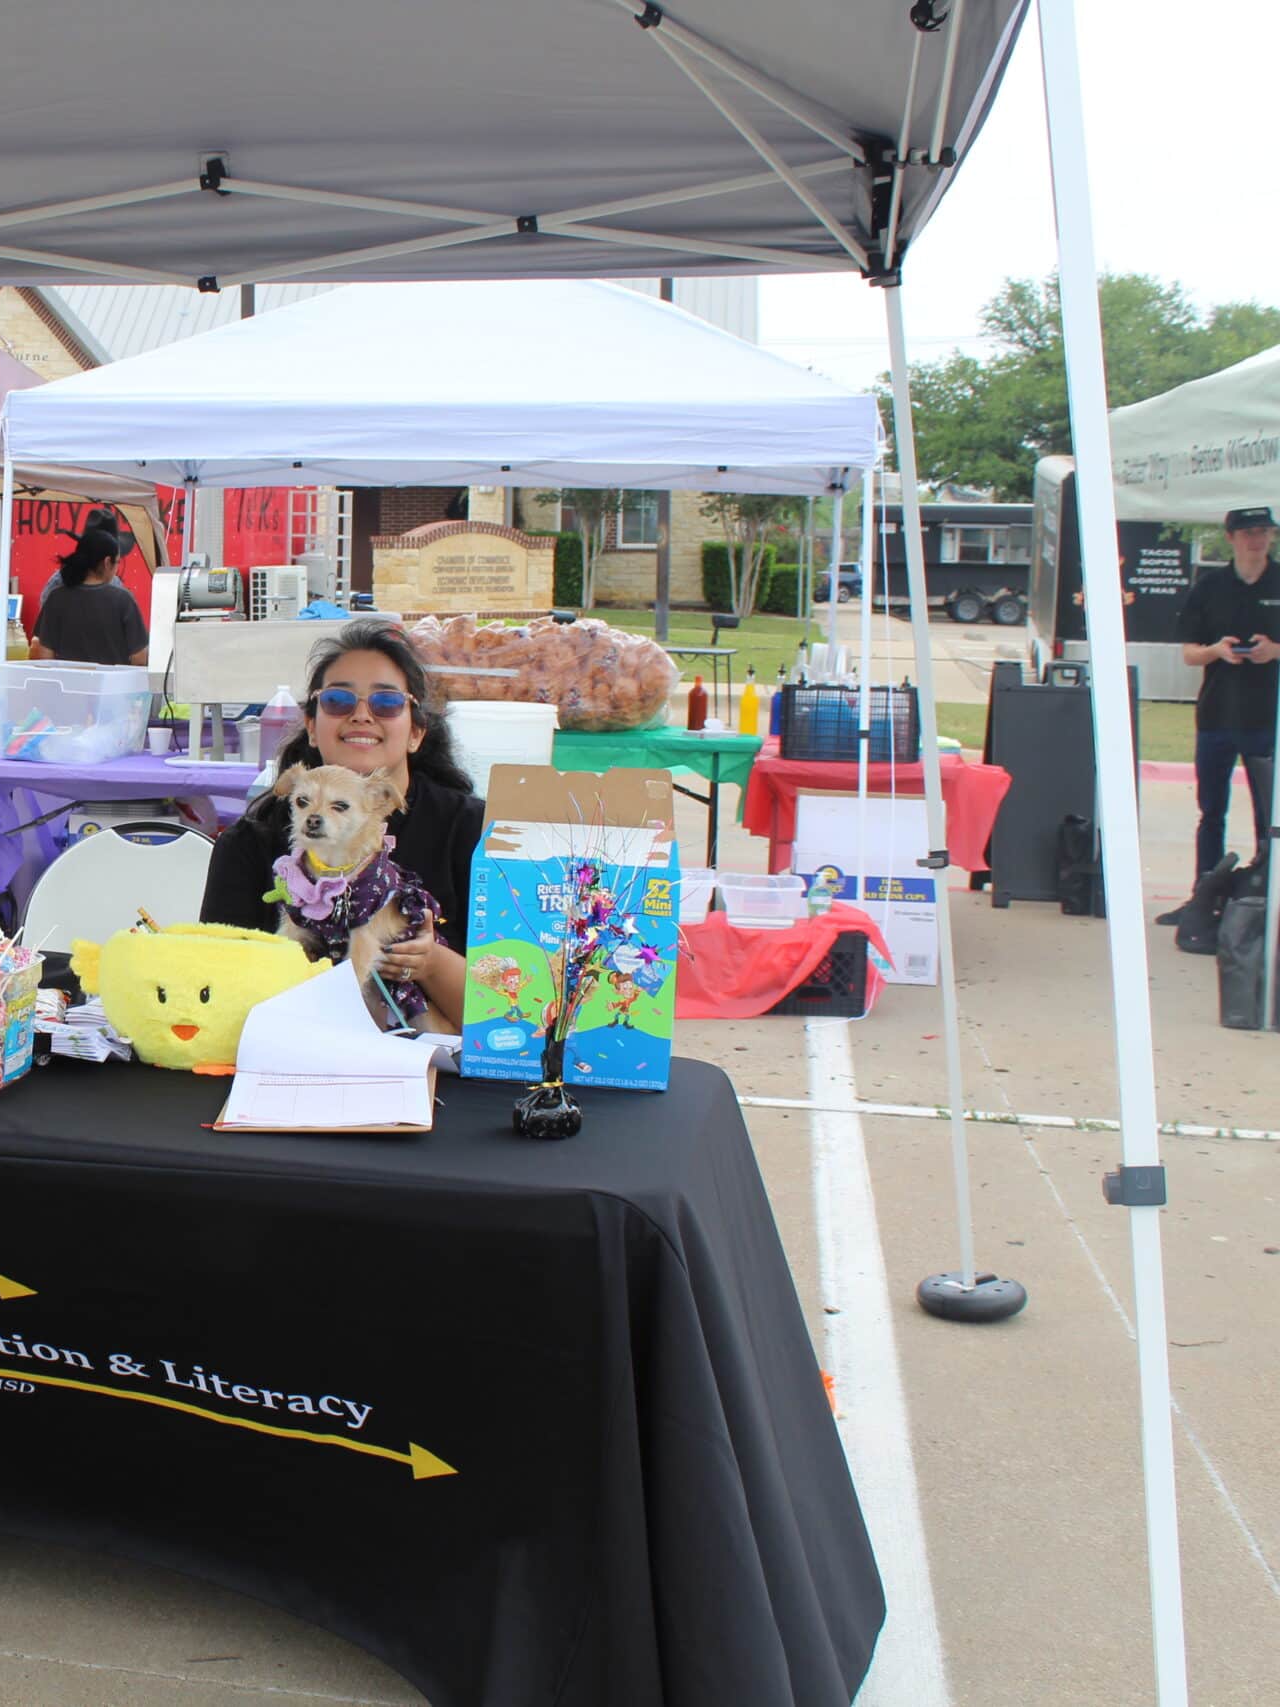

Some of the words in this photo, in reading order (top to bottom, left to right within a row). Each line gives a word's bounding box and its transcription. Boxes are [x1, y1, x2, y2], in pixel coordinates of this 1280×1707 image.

[19, 500, 83, 535] HOLY
[1140, 549, 1181, 557] TACOS
[1139, 558, 1180, 567] SOPES
[1136, 567, 1183, 576] TORTAS
[1128, 577, 1189, 586] GORDITAS
[536, 883, 562, 896] RICE
[647, 878, 671, 899] 52
[645, 899, 672, 911] Mini
[107, 1353, 151, 1379] &
[158, 1359, 374, 1429] Literacy
